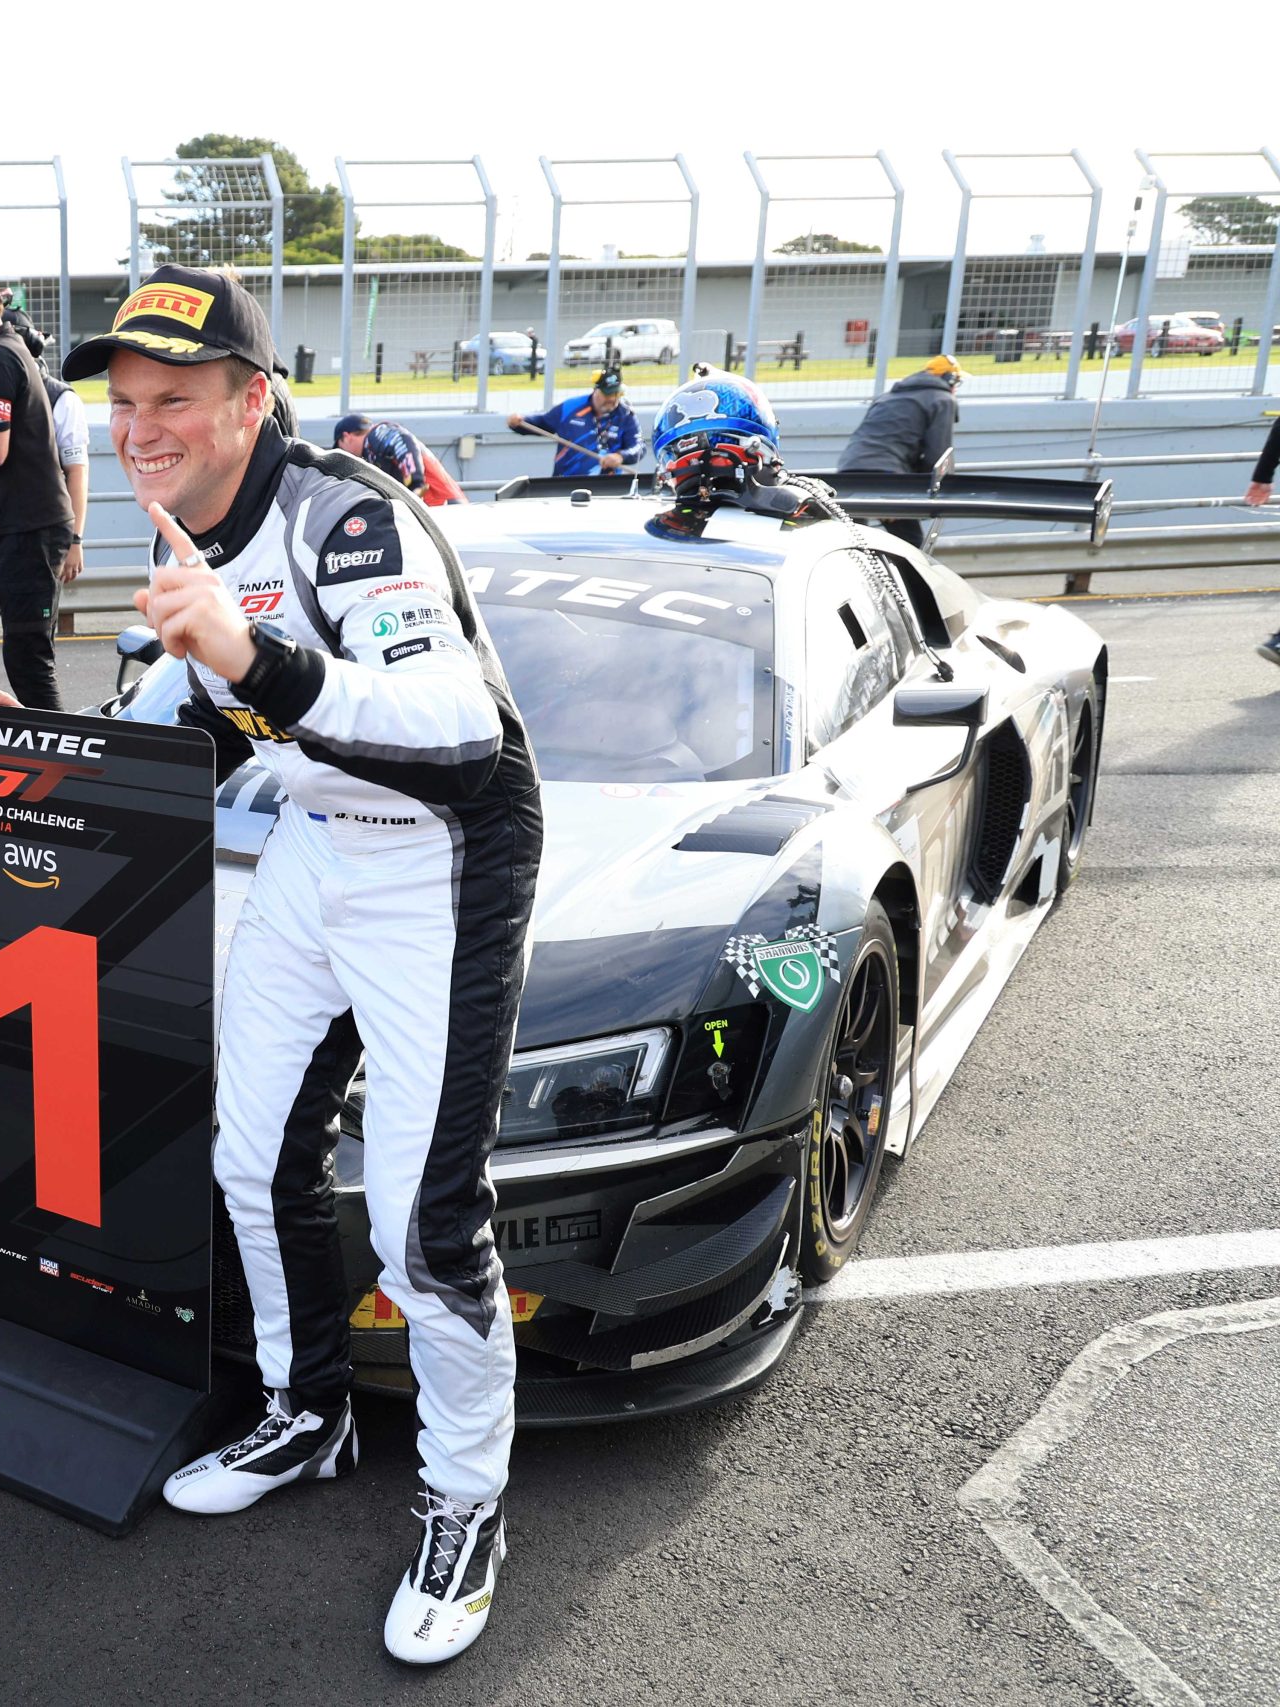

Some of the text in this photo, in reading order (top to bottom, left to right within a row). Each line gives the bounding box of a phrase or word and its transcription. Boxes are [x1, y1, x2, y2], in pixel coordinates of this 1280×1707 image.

[64, 448, 82, 457] SR
[325, 548, 384, 574] freem
[463, 566, 734, 627] ATEC
[6, 807, 86, 832] CHALLENGE
[4, 842, 58, 873] aws
[704, 1019, 728, 1031] OPEN
[491, 1217, 540, 1251] YLE
[40, 1257, 59, 1269] LIQUI
[40, 1265, 60, 1276] MOLY
[126, 1296, 161, 1313] AMADIO
[175, 1463, 210, 1480] freem
[414, 1608, 438, 1640] freem
